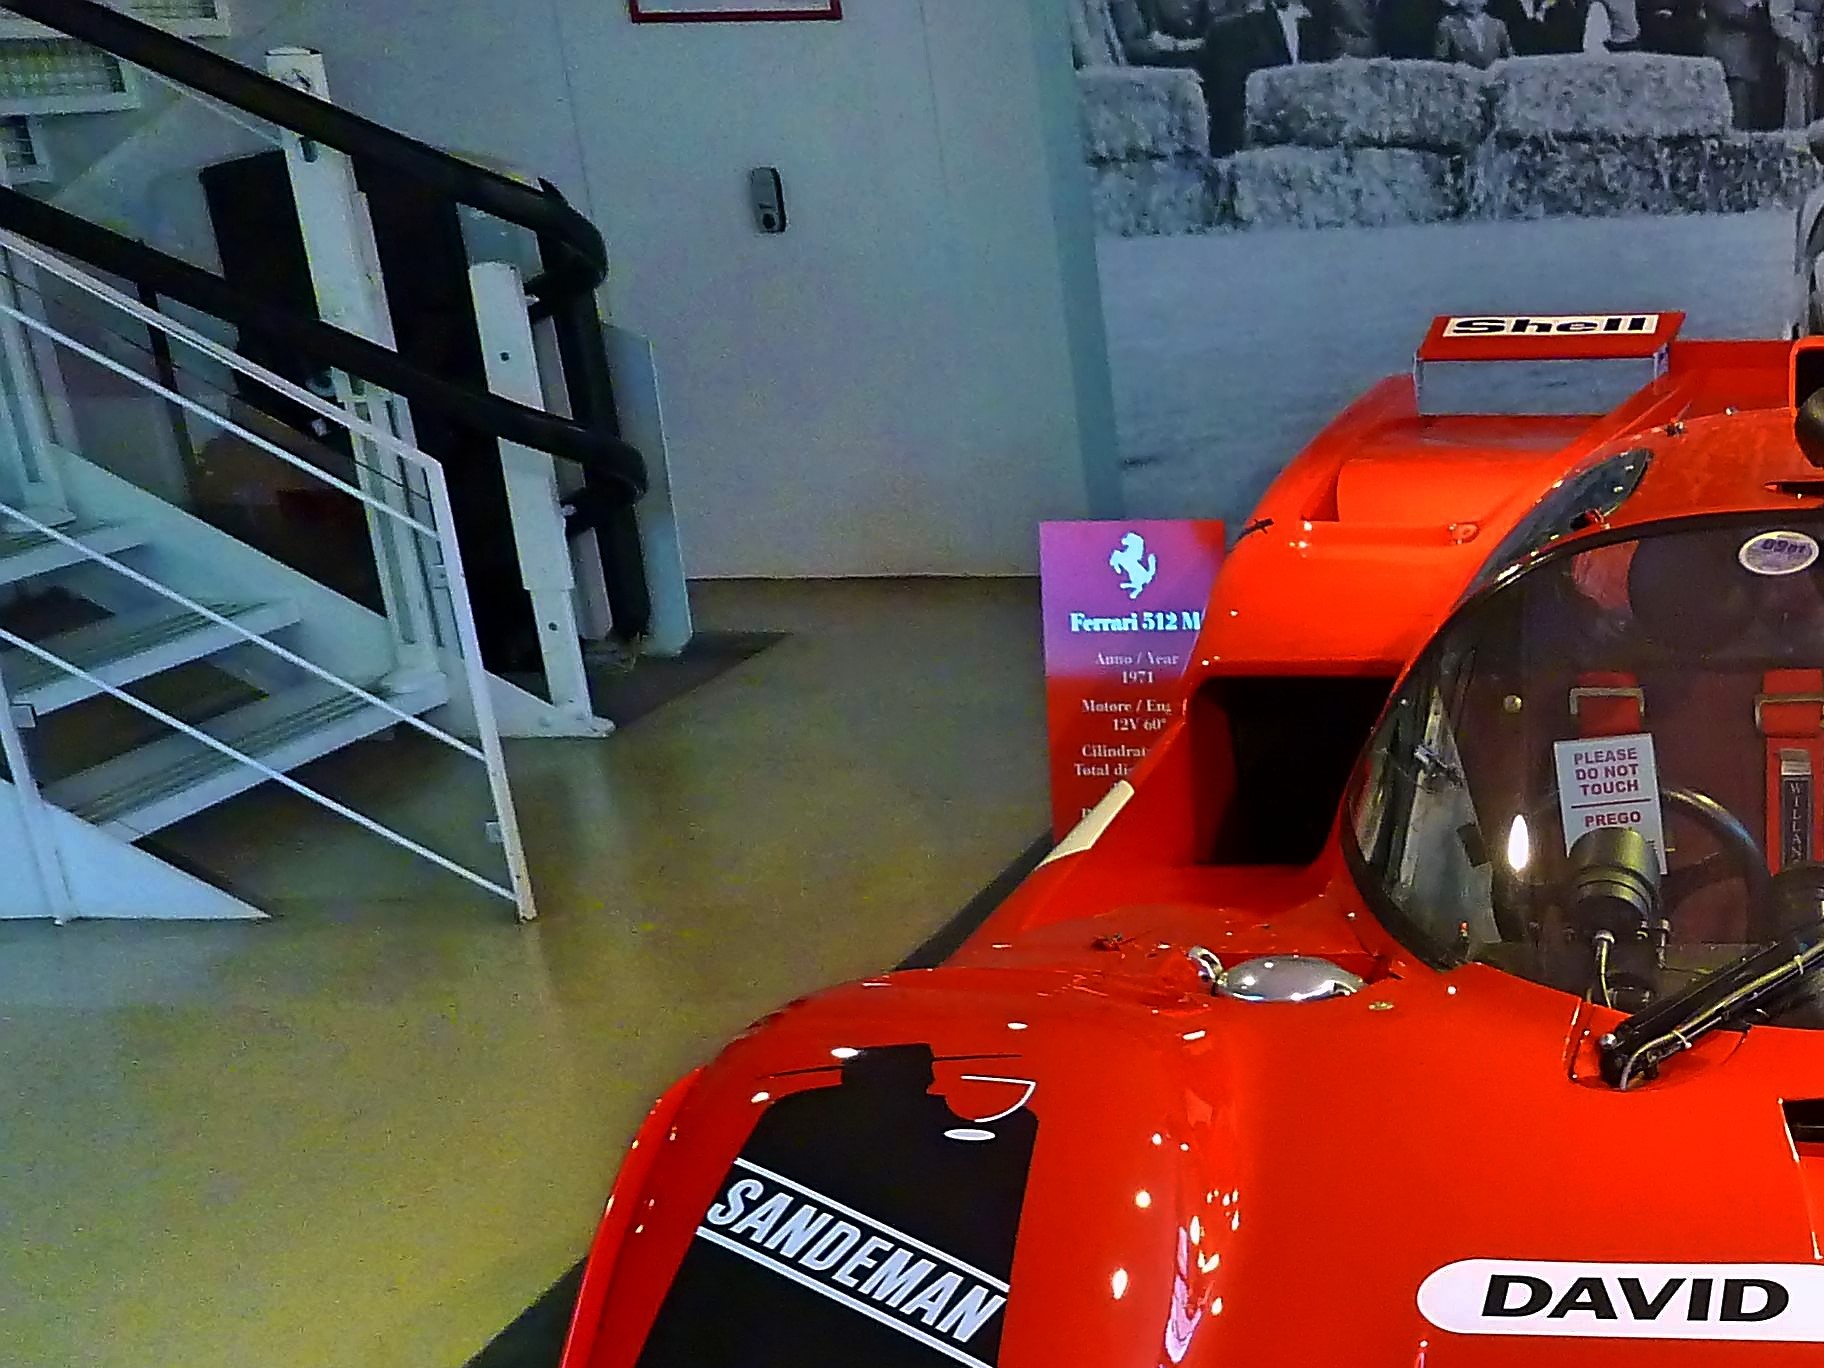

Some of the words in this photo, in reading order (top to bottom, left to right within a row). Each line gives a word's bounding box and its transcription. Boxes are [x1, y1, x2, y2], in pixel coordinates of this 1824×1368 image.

[1452, 317, 1647, 334] Shell
[1070, 612, 1139, 632] Ferrari
[1142, 611, 1178, 631] 512
[1182, 611, 1201, 631] M
[1096, 652, 1132, 665] Anno
[1147, 651, 1179, 665] Year
[1122, 671, 1154, 684] 1971
[1082, 699, 1132, 713] Motore
[1113, 718, 1138, 731] 12V
[1574, 748, 1638, 765] PLEASE
[1074, 763, 1110, 776] Total
[1575, 768, 1598, 780] DO
[1604, 764, 1639, 778] NOT
[1579, 779, 1639, 796] TOUCH
[1584, 811, 1641, 827] PREGO
[1789, 782, 1802, 864] WILLAN
[706, 1178, 1007, 1344] SANDEMAN
[1480, 1274, 1790, 1323] DAVID
